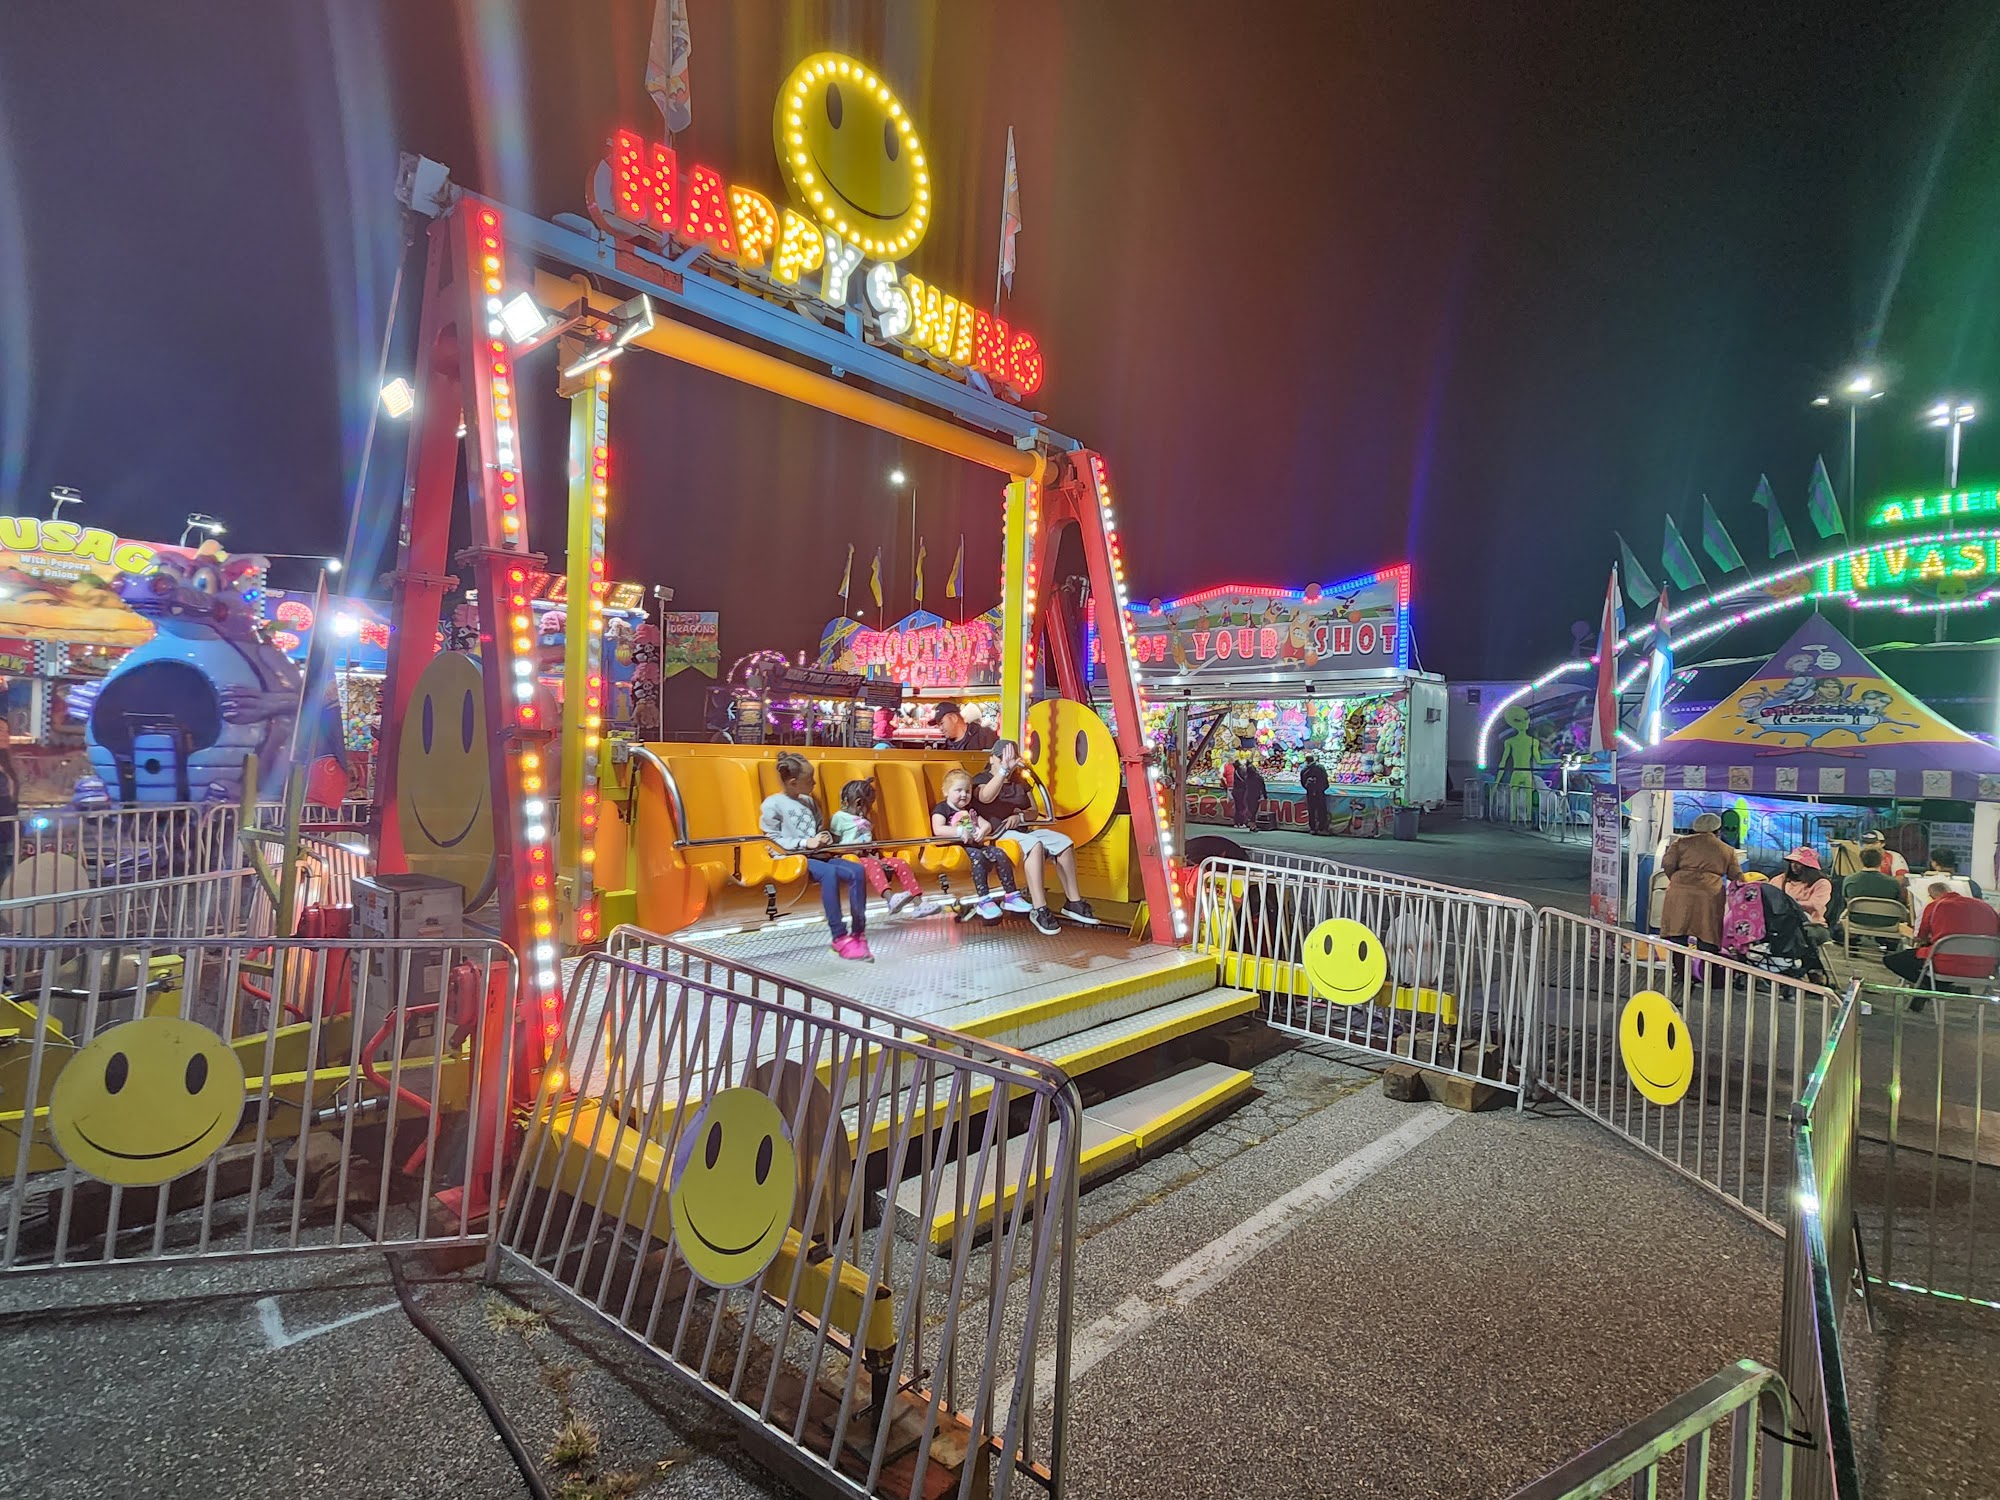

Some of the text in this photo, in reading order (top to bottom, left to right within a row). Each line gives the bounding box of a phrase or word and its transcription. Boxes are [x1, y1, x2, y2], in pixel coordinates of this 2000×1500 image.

[613, 129, 1044, 396] HAPPY SWING
[0, 517, 159, 576] USAG
[20, 554, 91, 572] With Peppers
[44, 569, 80, 580] Onions
[670, 624, 716, 634] DRAGONS
[1192, 628, 1278, 660] YOUR
[1315, 623, 1398, 655] SHOT
[910, 659, 969, 687] CITY
[1789, 715, 1847, 724] Caricatures
